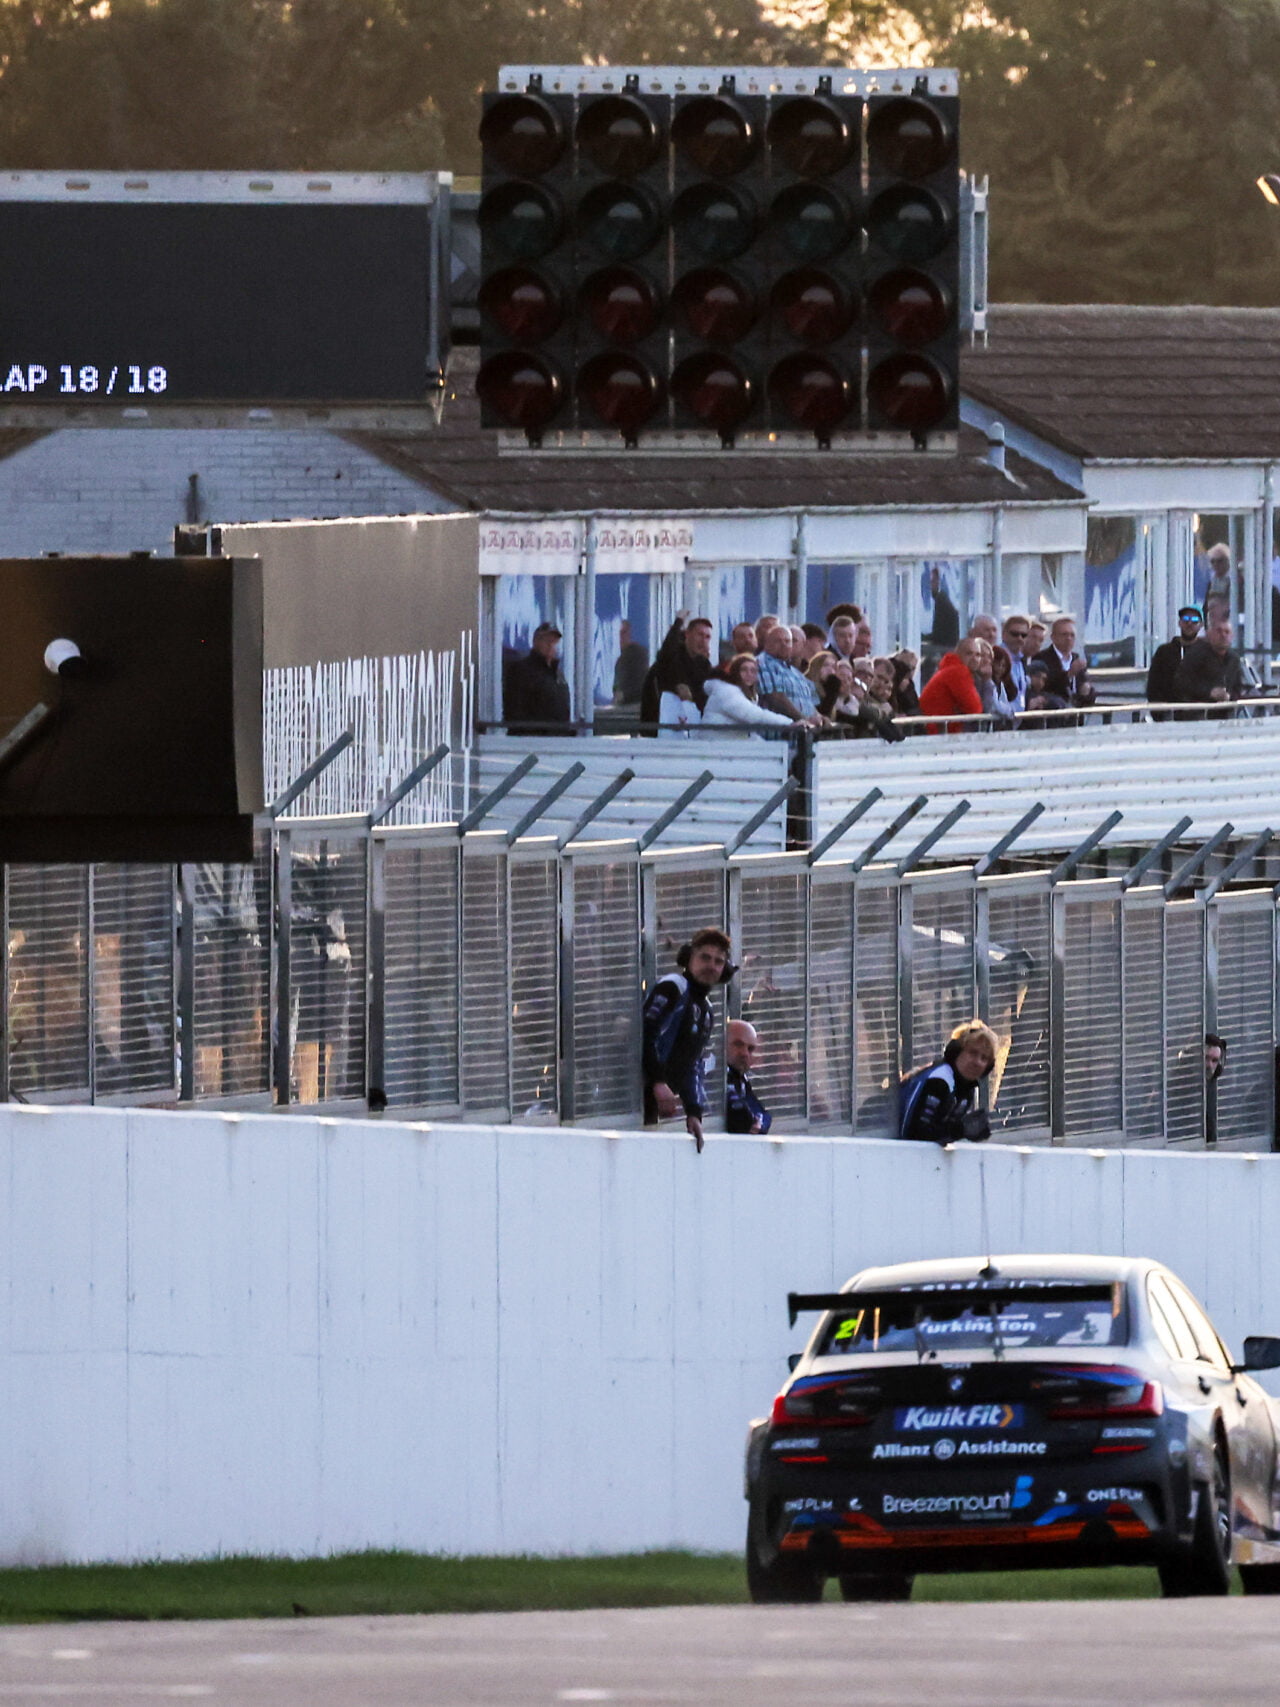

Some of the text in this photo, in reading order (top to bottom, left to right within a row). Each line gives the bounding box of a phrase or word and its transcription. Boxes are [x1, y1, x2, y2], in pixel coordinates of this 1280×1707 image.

[0, 364, 48, 392] AP
[872, 1440, 1048, 1459] Allianz Assistance
[882, 1492, 1011, 1514] Breezemount
